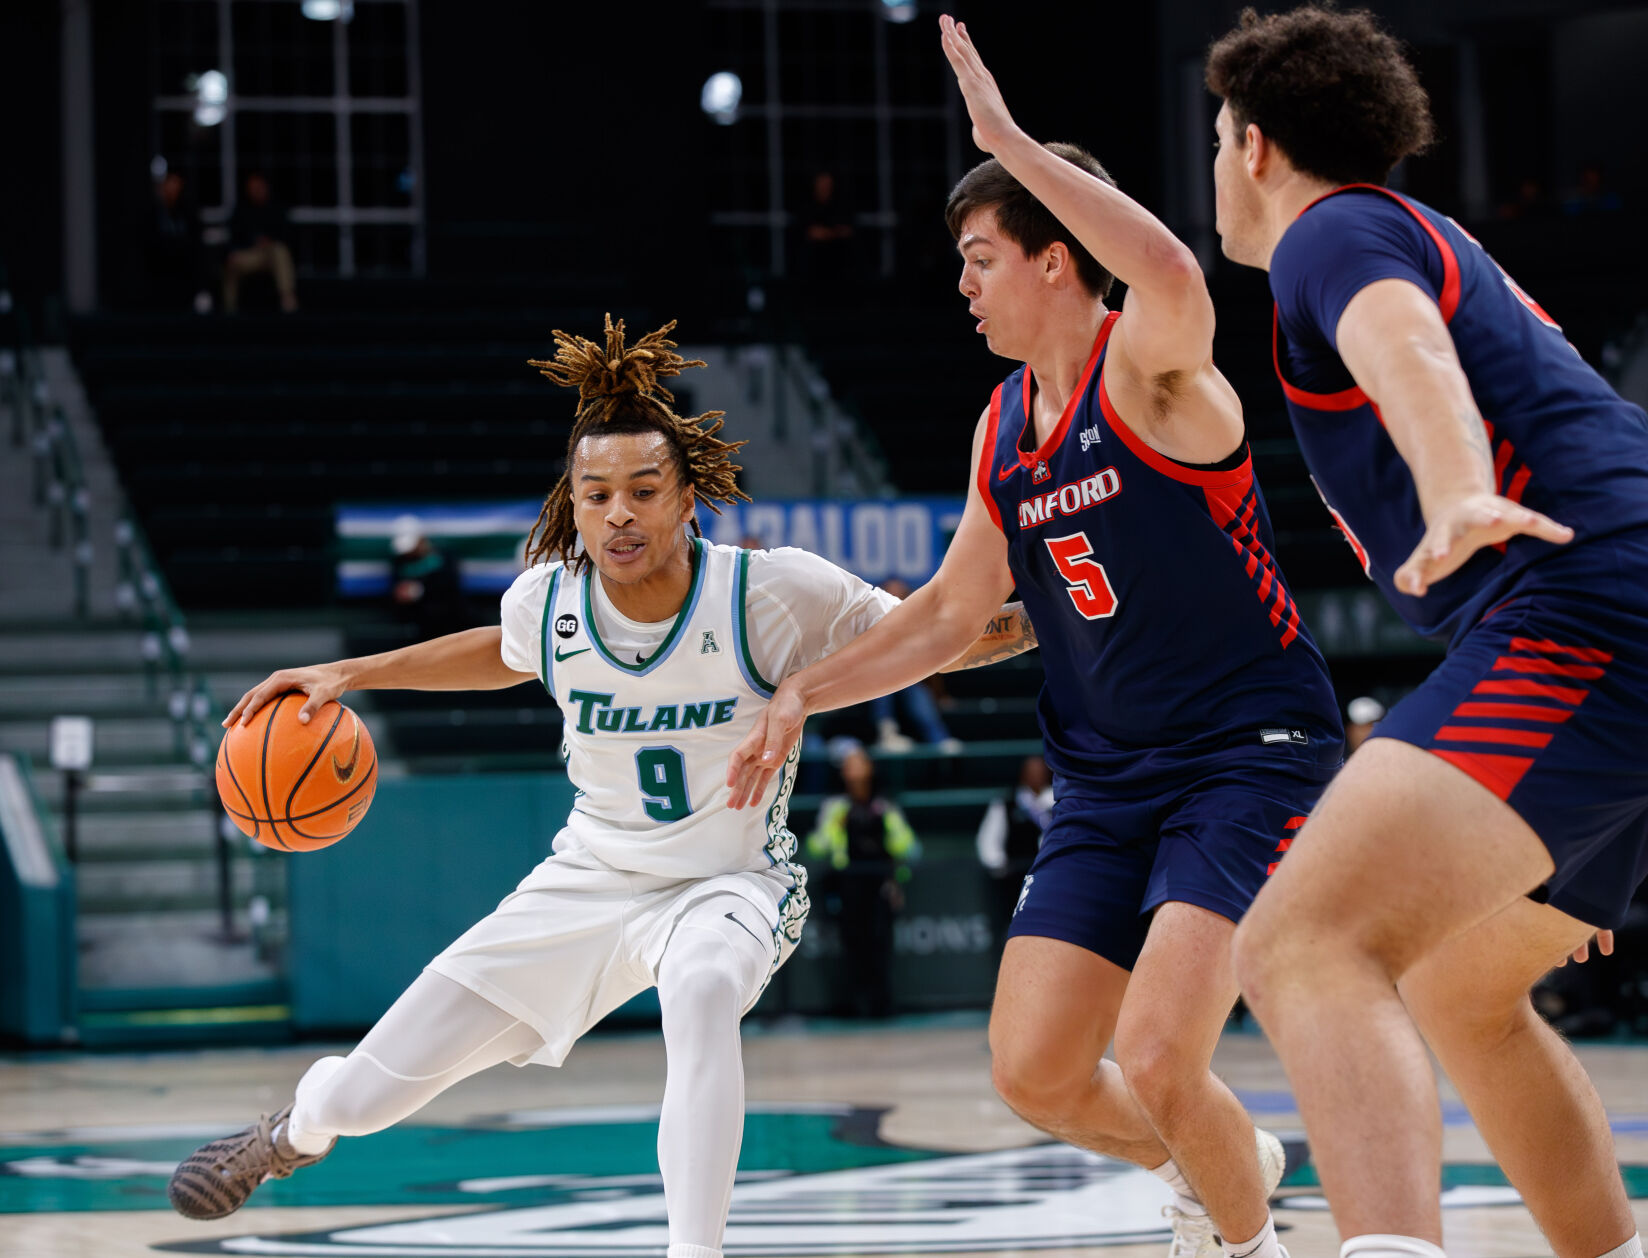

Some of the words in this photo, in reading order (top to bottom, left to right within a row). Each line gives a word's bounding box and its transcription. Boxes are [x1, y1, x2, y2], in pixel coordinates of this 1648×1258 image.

[1019, 467, 1121, 528] MFORD
[1044, 531, 1118, 620] 5
[557, 619, 576, 632] GG
[568, 688, 739, 735] TULANE
[1291, 730, 1304, 739] XL
[634, 745, 694, 823] 9
